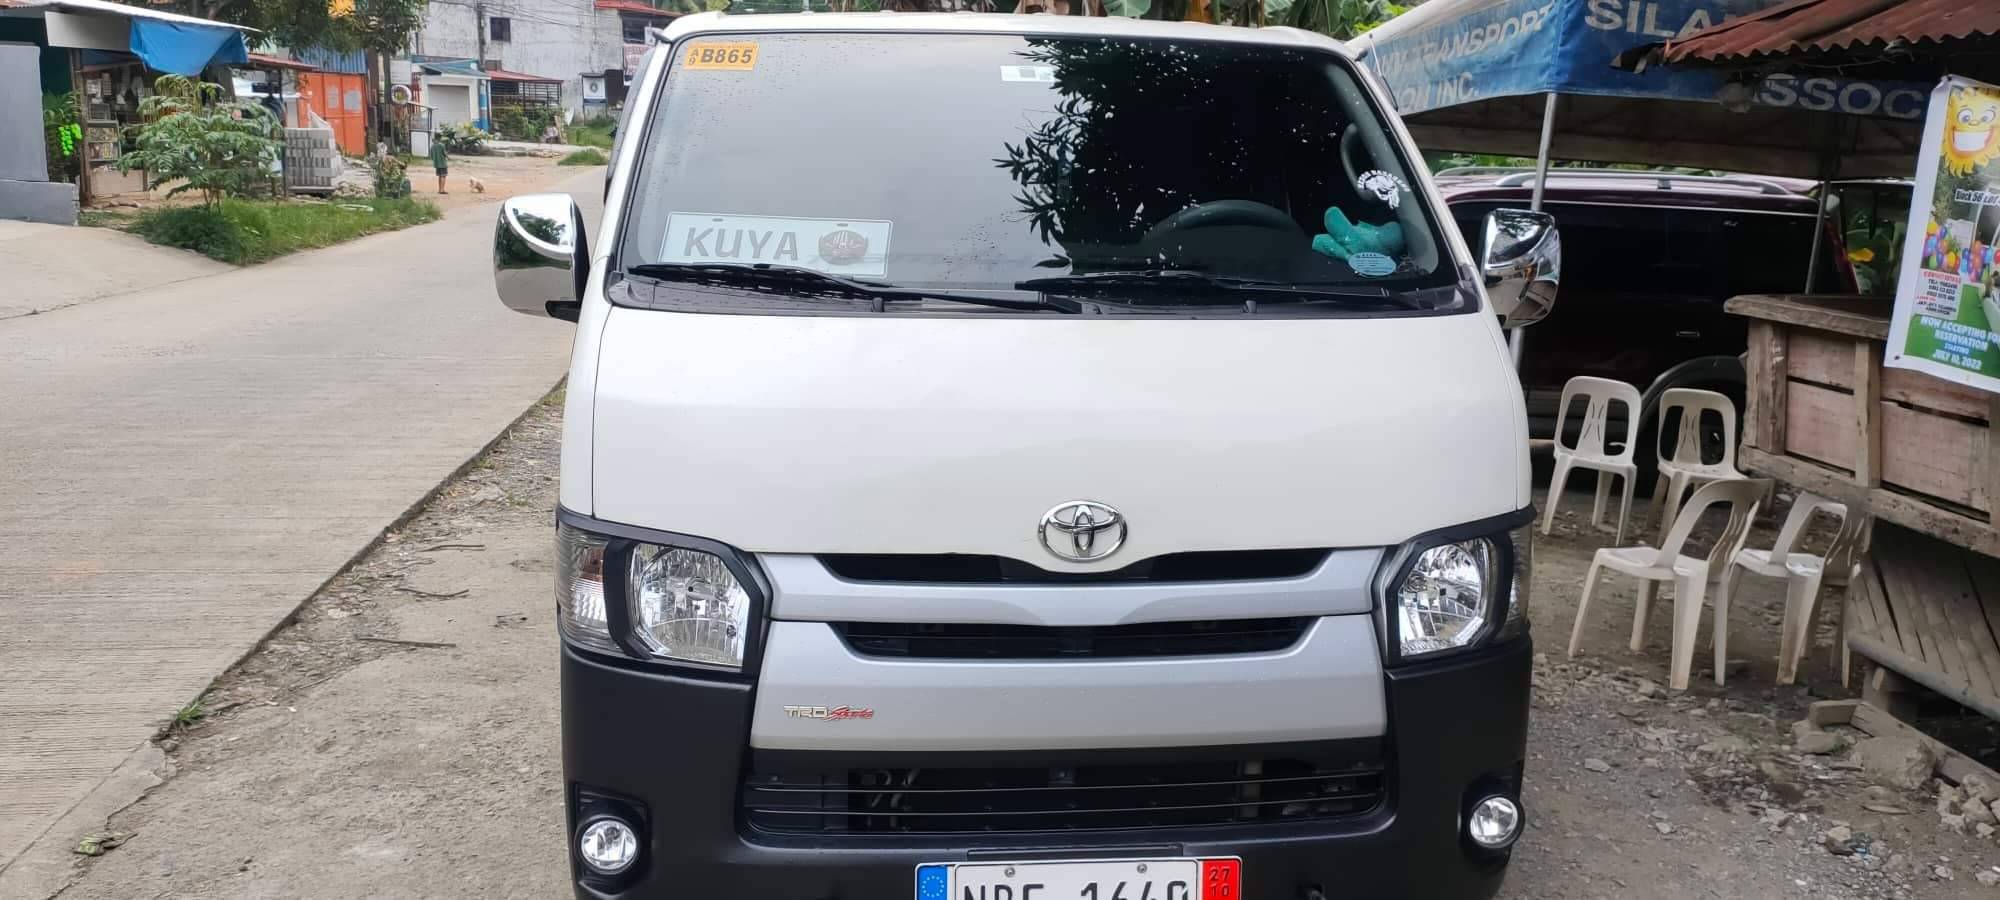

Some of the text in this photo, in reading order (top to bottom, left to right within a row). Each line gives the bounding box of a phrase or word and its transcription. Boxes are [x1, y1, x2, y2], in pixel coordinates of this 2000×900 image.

[1585, 0, 1737, 43] SILA
[701, 48, 753, 64] B865
[1753, 73, 1924, 119] SSOC
[684, 227, 798, 261] KUYA
[1920, 315, 1941, 328] NOW
[1941, 320, 1987, 340] ACCEPTING
[1934, 329, 1989, 352] RESERVATION
[1209, 867, 1231, 880] 27
[1210, 884, 1231, 897] 10
